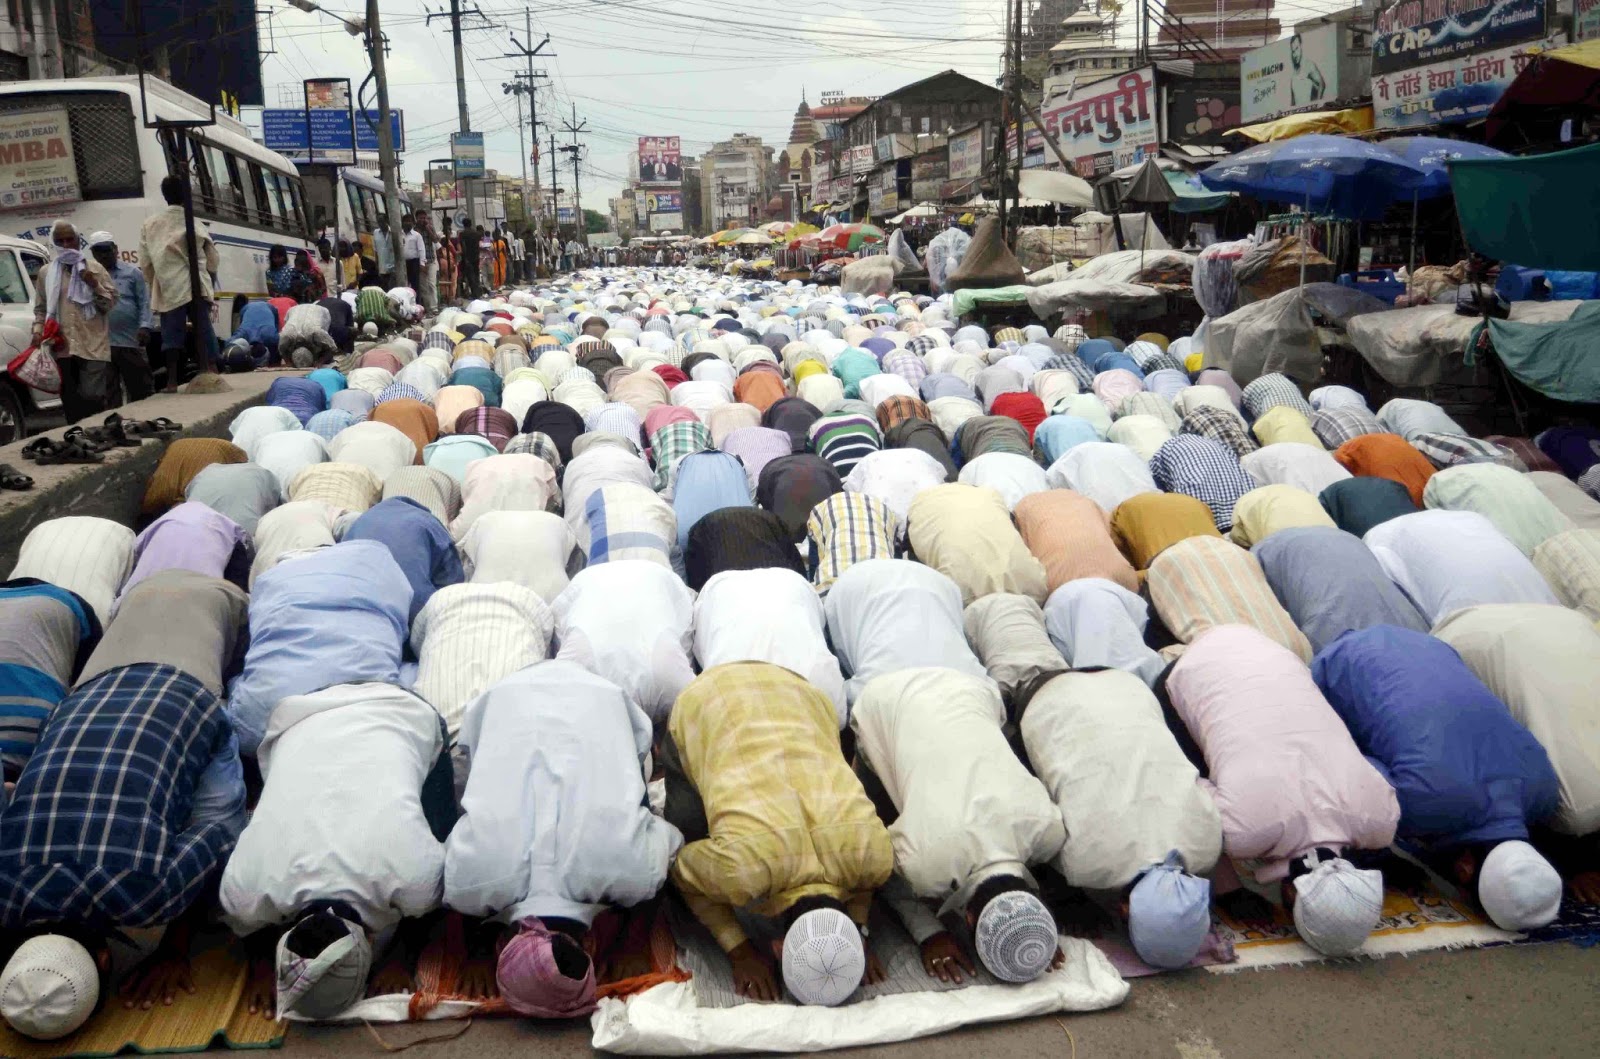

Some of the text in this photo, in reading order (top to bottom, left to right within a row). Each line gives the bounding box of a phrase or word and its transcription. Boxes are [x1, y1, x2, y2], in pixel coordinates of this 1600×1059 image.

[1491, 7, 1537, 28] Air-Conditioned
[1389, 27, 1431, 54] CAP
[1418, 49, 1431, 59] New
[1456, 41, 1475, 51] Patna
[1261, 62, 1284, 78] MACHO
[1426, 69, 1456, 92] हेयर
[1461, 56, 1505, 86] कटिंग
[820, 96, 883, 106] CITY CENT
[1042, 73, 1152, 144] इन्द्रपुरी
[14, 129, 31, 139] JOB
[32, 125, 60, 137] READY
[0, 138, 68, 165] MBA
[20, 186, 76, 204] CIMAGE
